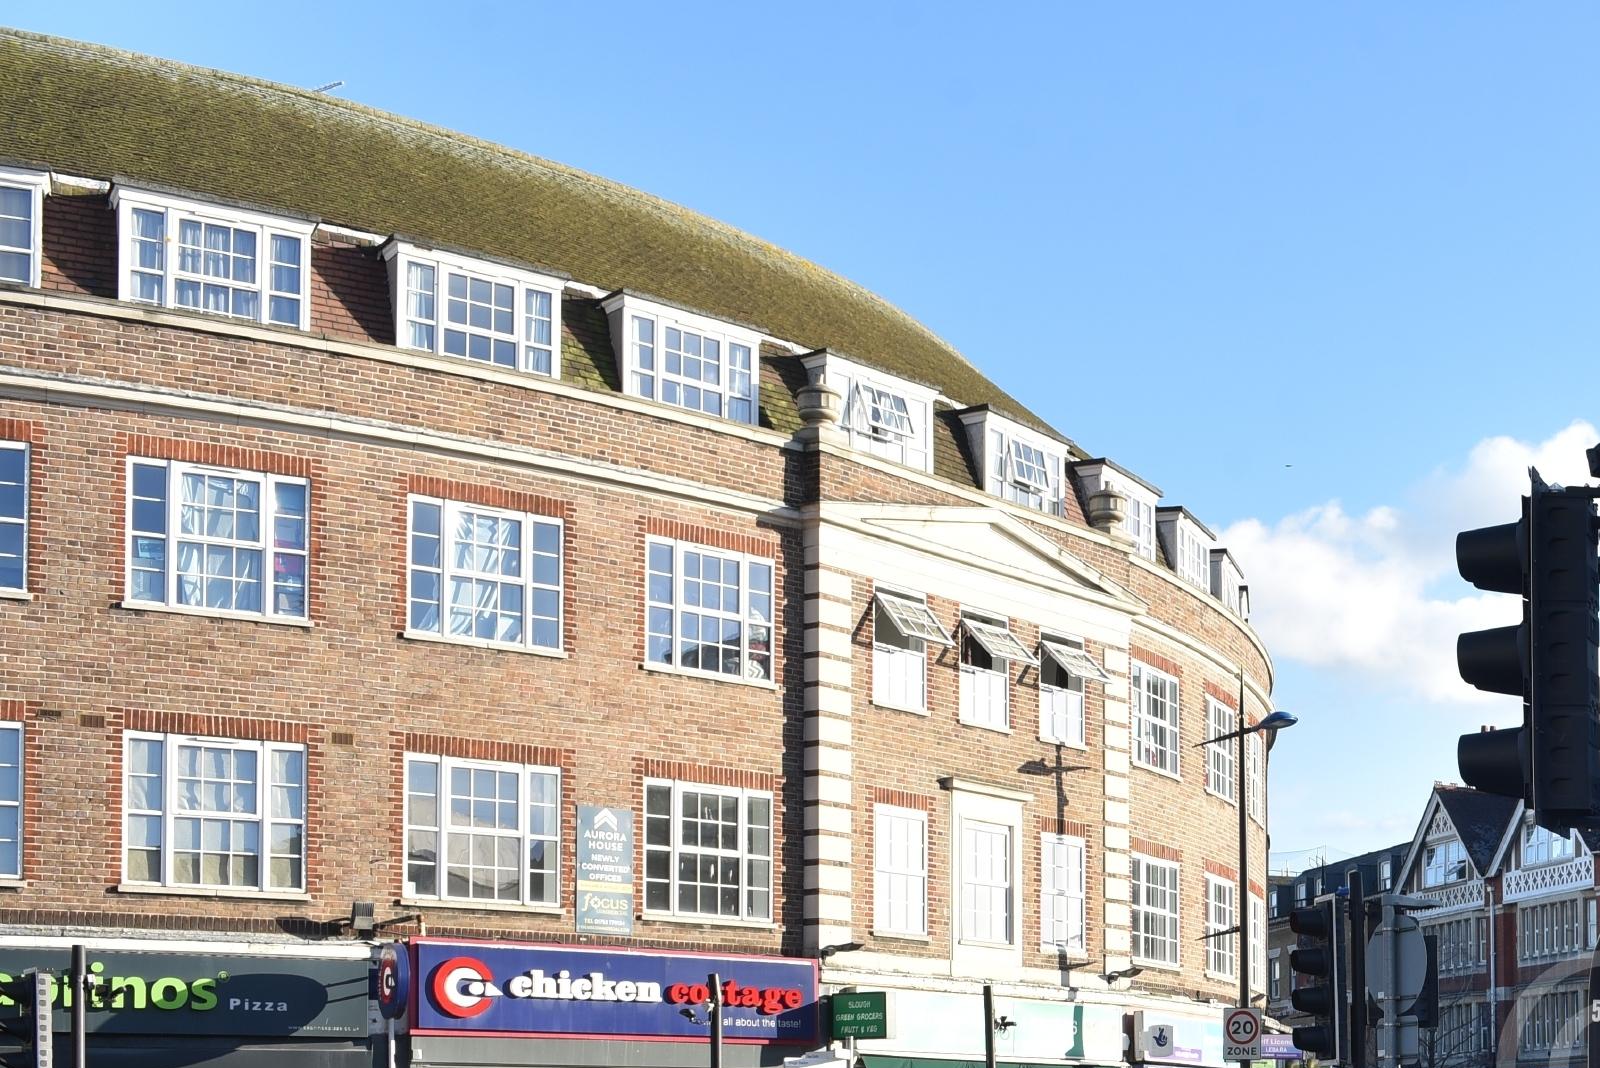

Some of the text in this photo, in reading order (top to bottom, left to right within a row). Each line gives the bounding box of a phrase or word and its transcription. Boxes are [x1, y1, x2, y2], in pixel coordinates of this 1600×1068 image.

[584, 830, 627, 842] AURORA
[588, 841, 624, 851] HOUSE
[510, 970, 802, 1013] chicken cotage
[229, 998, 288, 1011] Pizza
[848, 1001, 871, 1009] SLOUGH
[723, 1017, 733, 1026] all
[735, 1017, 760, 1027] about
[762, 1018, 776, 1027] the
[1232, 1021, 1253, 1035] 20
[1227, 1047, 1257, 1055] ZONE
